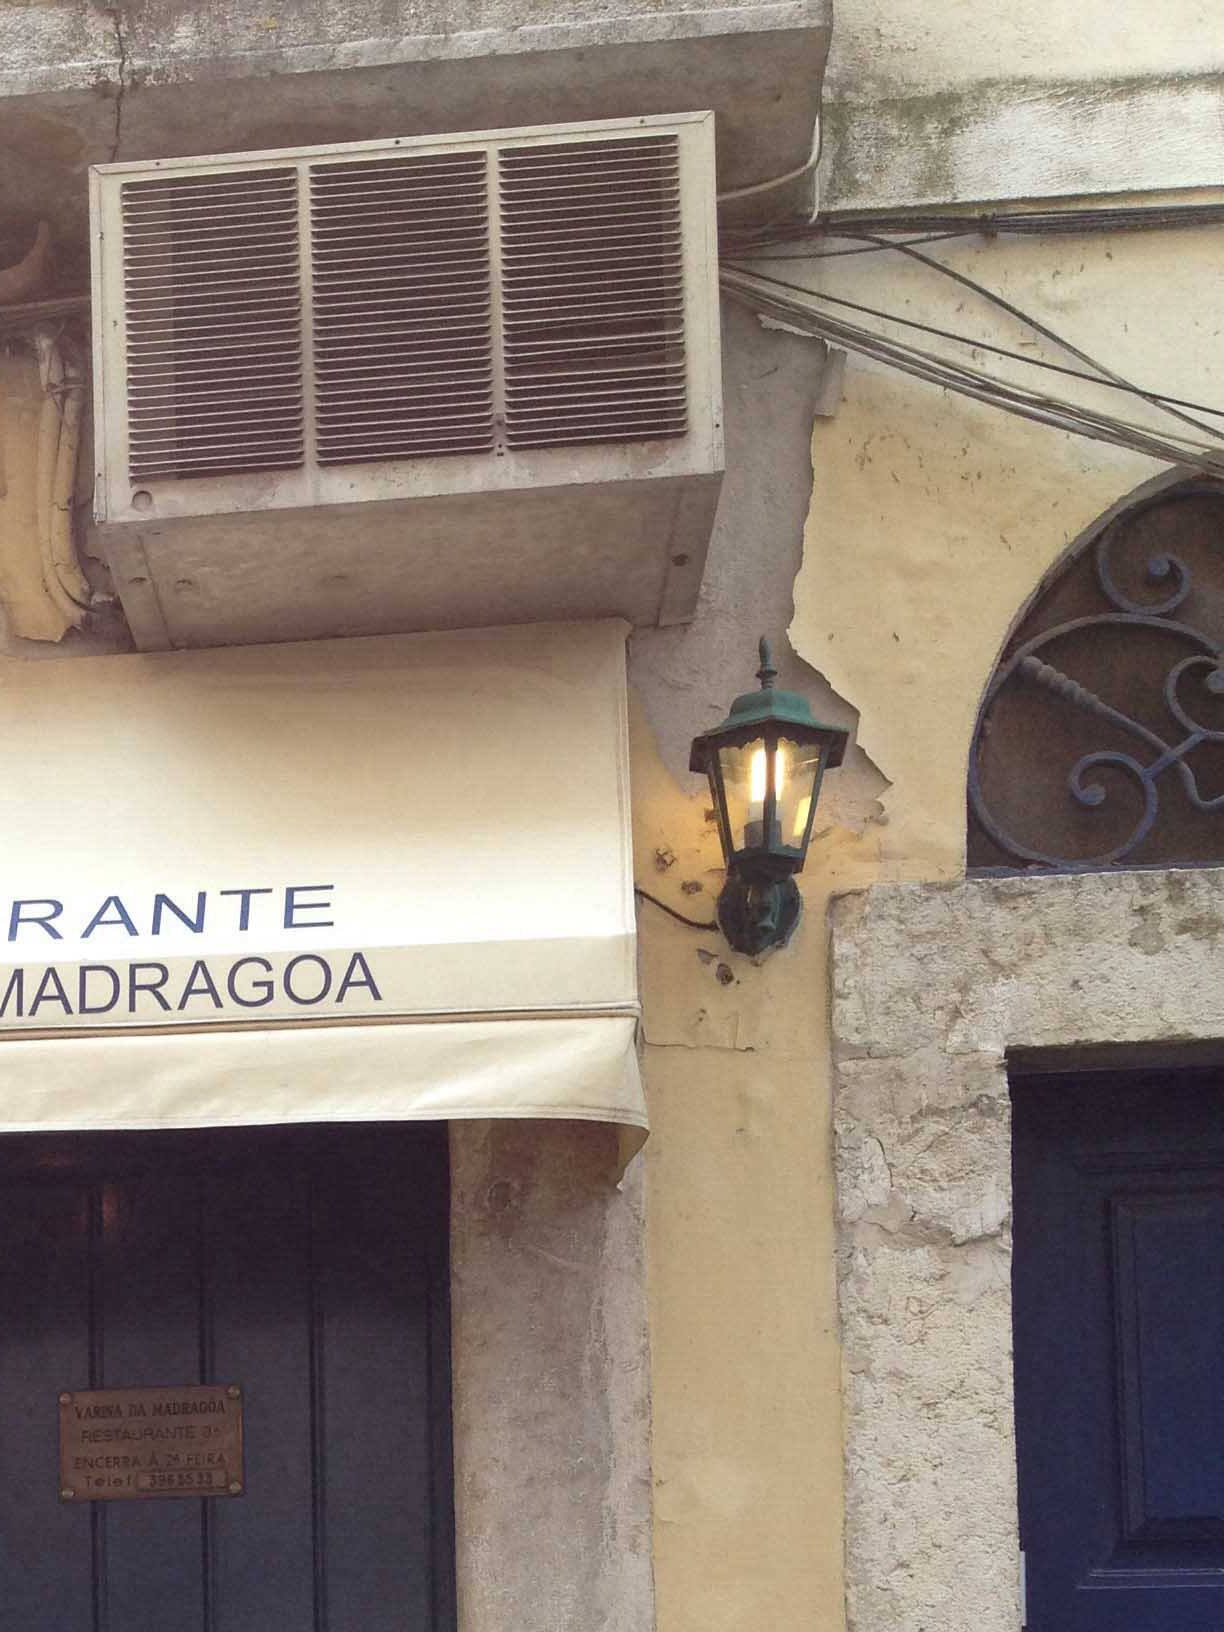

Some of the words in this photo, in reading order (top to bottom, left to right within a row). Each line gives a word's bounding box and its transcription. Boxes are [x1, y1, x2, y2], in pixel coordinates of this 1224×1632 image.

[73, 1403, 123, 1420] VARINA
[128, 1402, 147, 1418] DA
[151, 1399, 226, 1417] MADRAGOA
[80, 1425, 197, 1444] RESTAURANTE
[73, 1455, 142, 1471] ENCERRA
[186, 1452, 227, 1467] FEIRA
